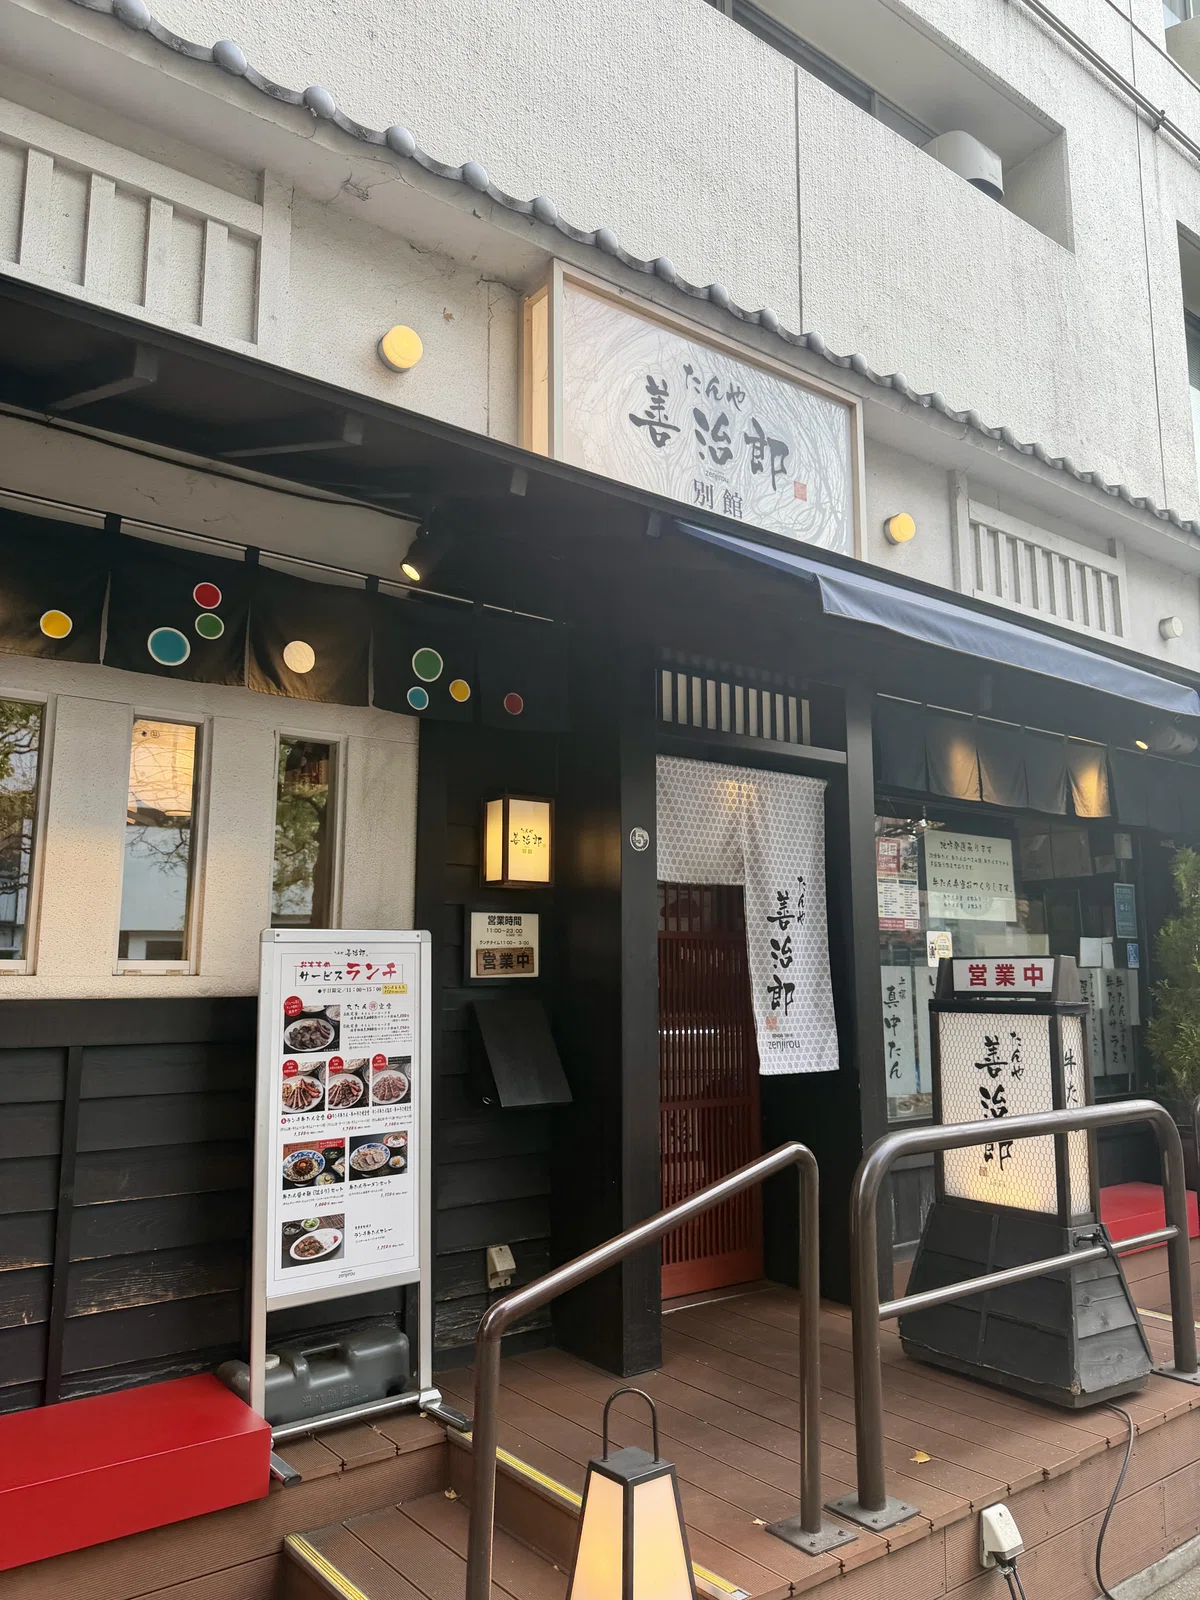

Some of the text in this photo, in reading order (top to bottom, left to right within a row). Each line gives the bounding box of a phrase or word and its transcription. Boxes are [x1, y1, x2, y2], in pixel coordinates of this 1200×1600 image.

[683, 363, 746, 411] たんや
[629, 375, 789, 491] 善治郎
[694, 479, 743, 519] 別館
[487, 915, 522, 926] 営業時間
[797, 875, 807, 926] たんや
[482, 951, 530, 971] 営業中
[766, 890, 795, 1016] 善治郎
[968, 963, 1044, 988] 営業中
[768, 1038, 800, 1052] zenjirou
[884, 985, 902, 1080] 真中たん
[1010, 1031, 1024, 1080] たんや
[1064, 1048, 1080, 1110] 牛た
